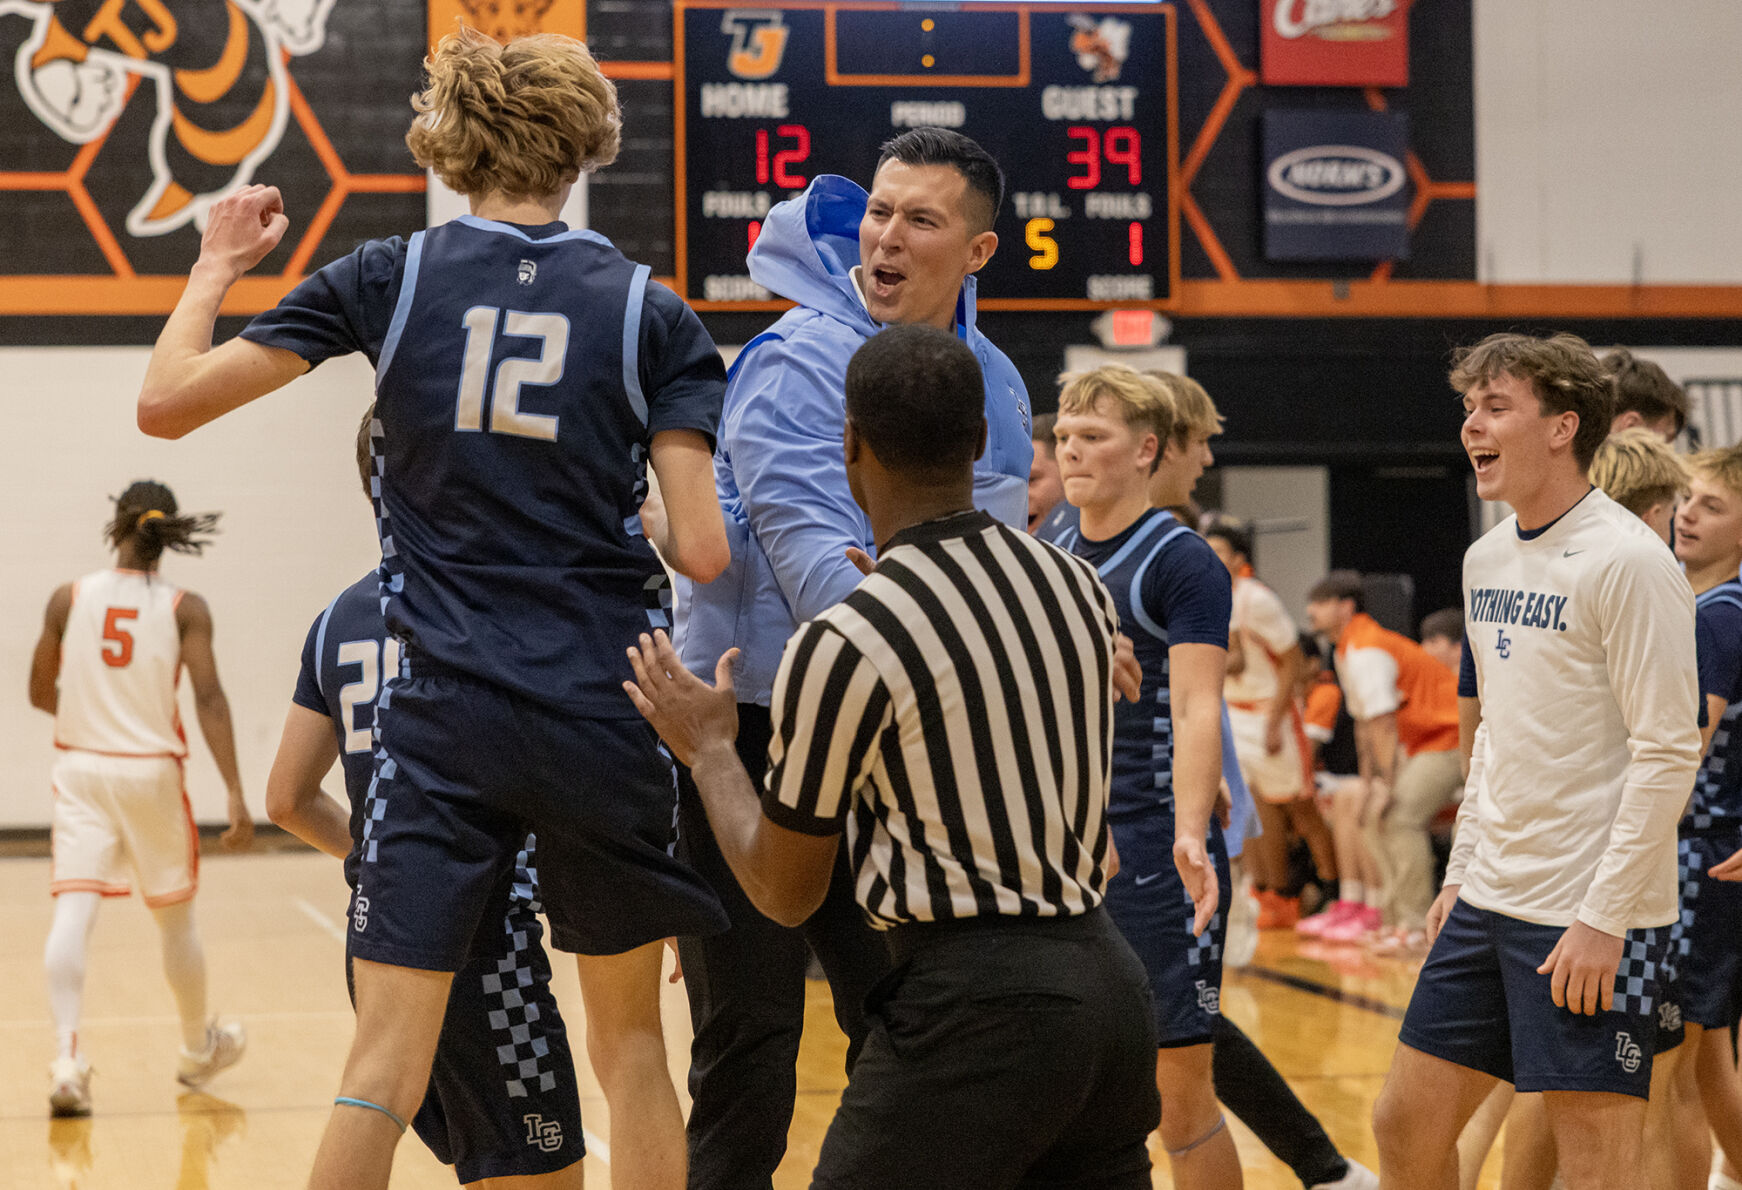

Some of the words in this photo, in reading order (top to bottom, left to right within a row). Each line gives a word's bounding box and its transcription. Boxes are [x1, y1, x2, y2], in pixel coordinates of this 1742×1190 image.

[721, 8, 790, 80] TJ
[701, 82, 790, 118] HOME
[891, 101, 966, 128] PERIOD
[1042, 86, 1138, 121] GUEST
[756, 125, 810, 188] 12
[1067, 126, 1142, 189] 39
[702, 190, 770, 218] FOULS
[1085, 192, 1152, 219] FOULS
[1025, 217, 1059, 270] 5
[1129, 221, 1143, 266] 1
[454, 305, 570, 442] 12
[1469, 588, 1525, 625] NOTHING
[1521, 592, 1568, 632] EASY.
[101, 607, 139, 668] 5
[1495, 629, 1511, 659] LC
[524, 1114, 563, 1152] LC
